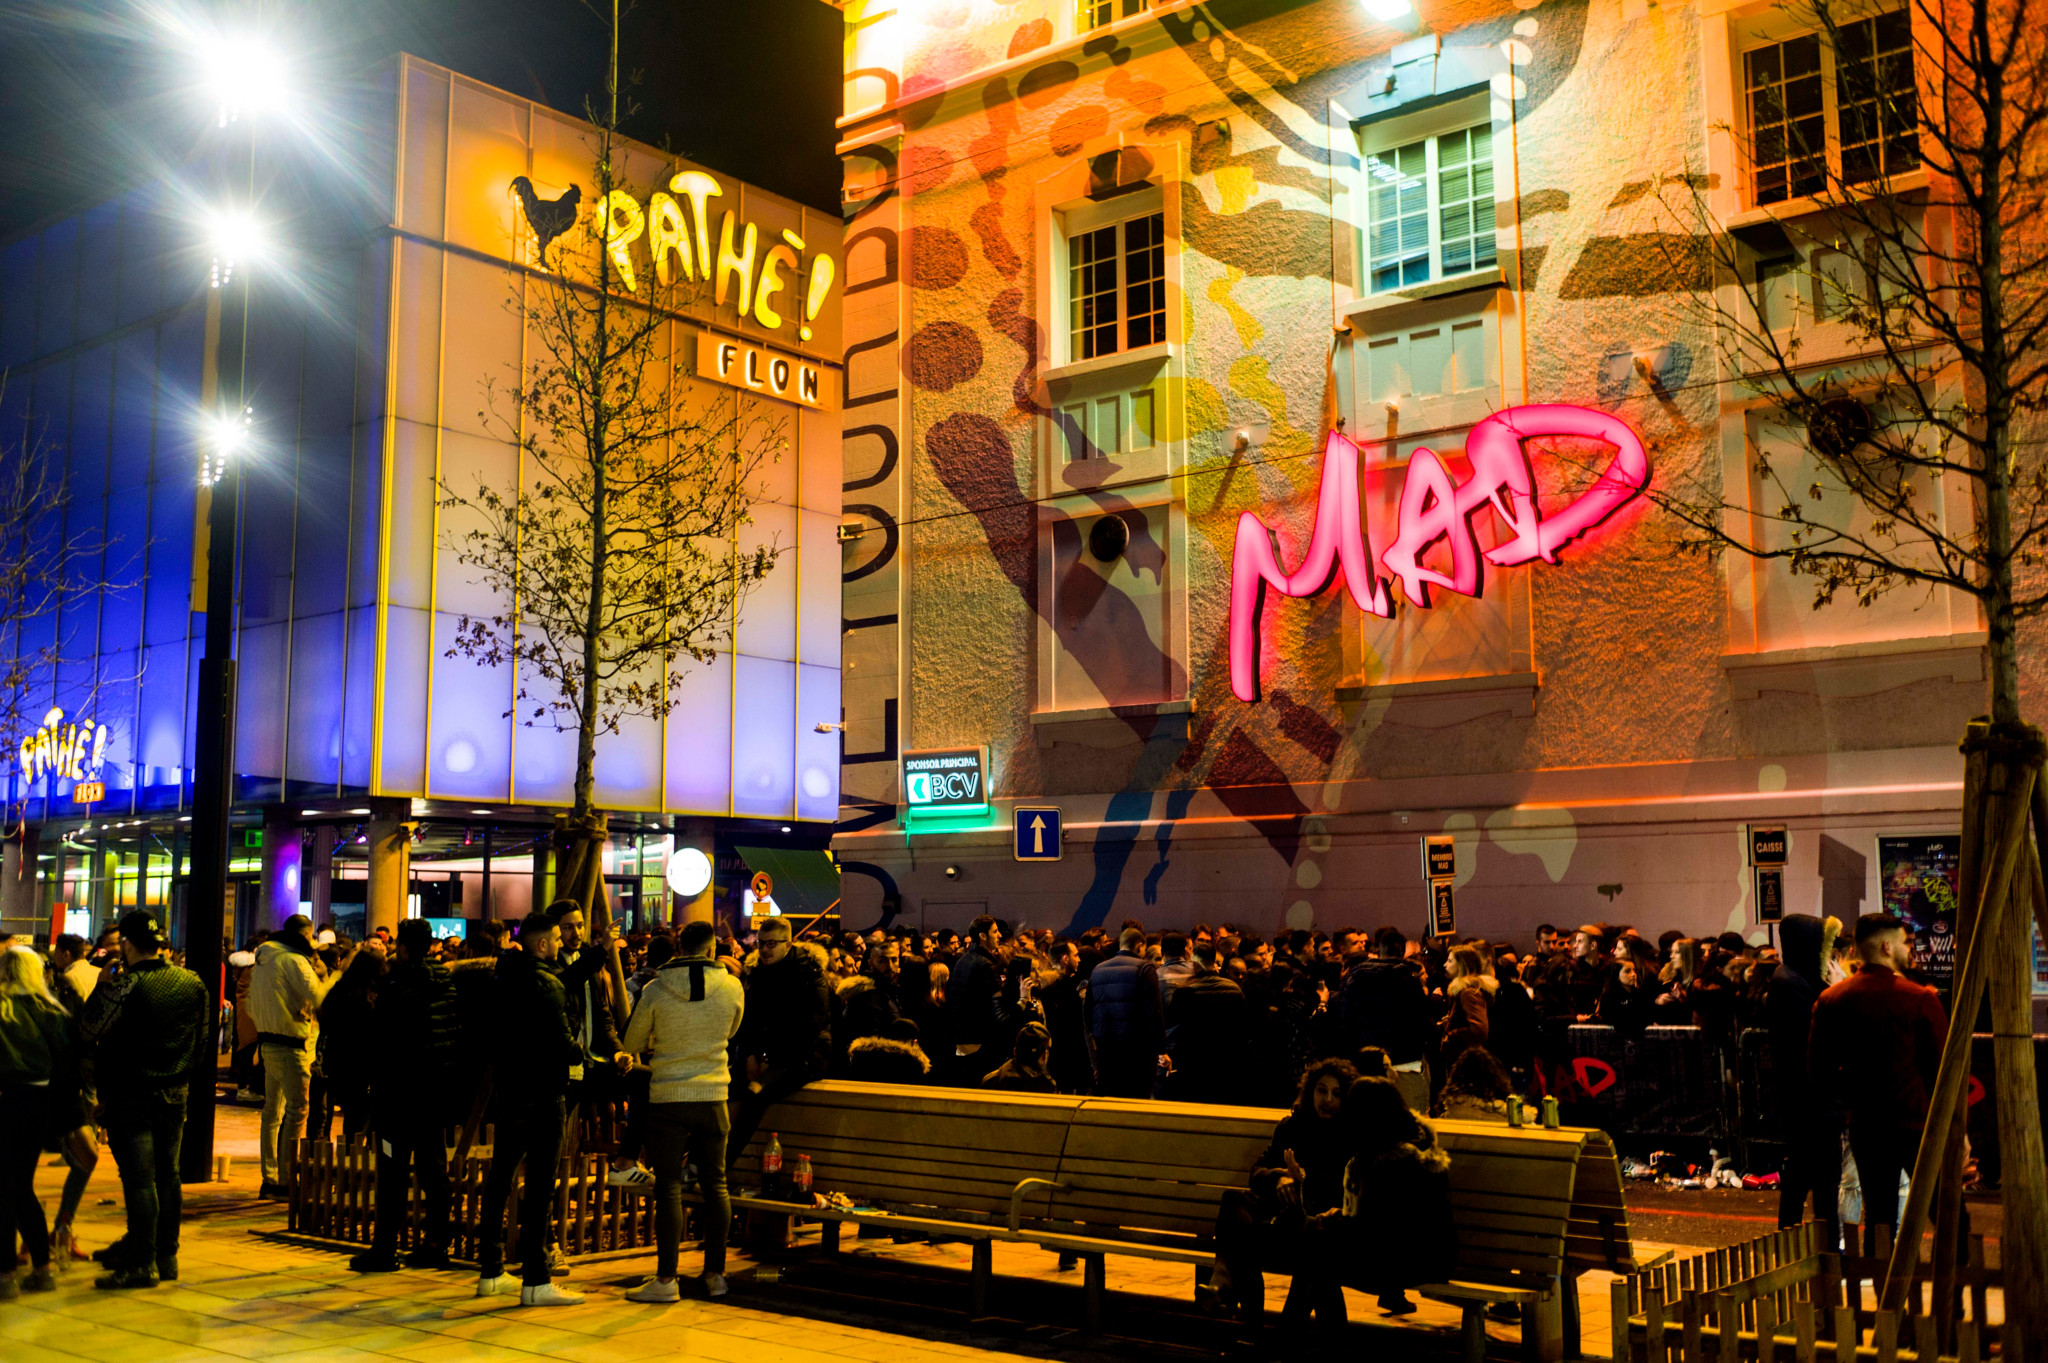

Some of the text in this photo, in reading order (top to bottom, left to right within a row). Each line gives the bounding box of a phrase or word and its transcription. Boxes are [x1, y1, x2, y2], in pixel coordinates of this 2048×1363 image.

[717, 342, 818, 404] FLON
[906, 757, 978, 771] SPONSOR PRINCIPAL
[931, 772, 979, 800] BCV
[1755, 841, 1784, 854] CAISSE
